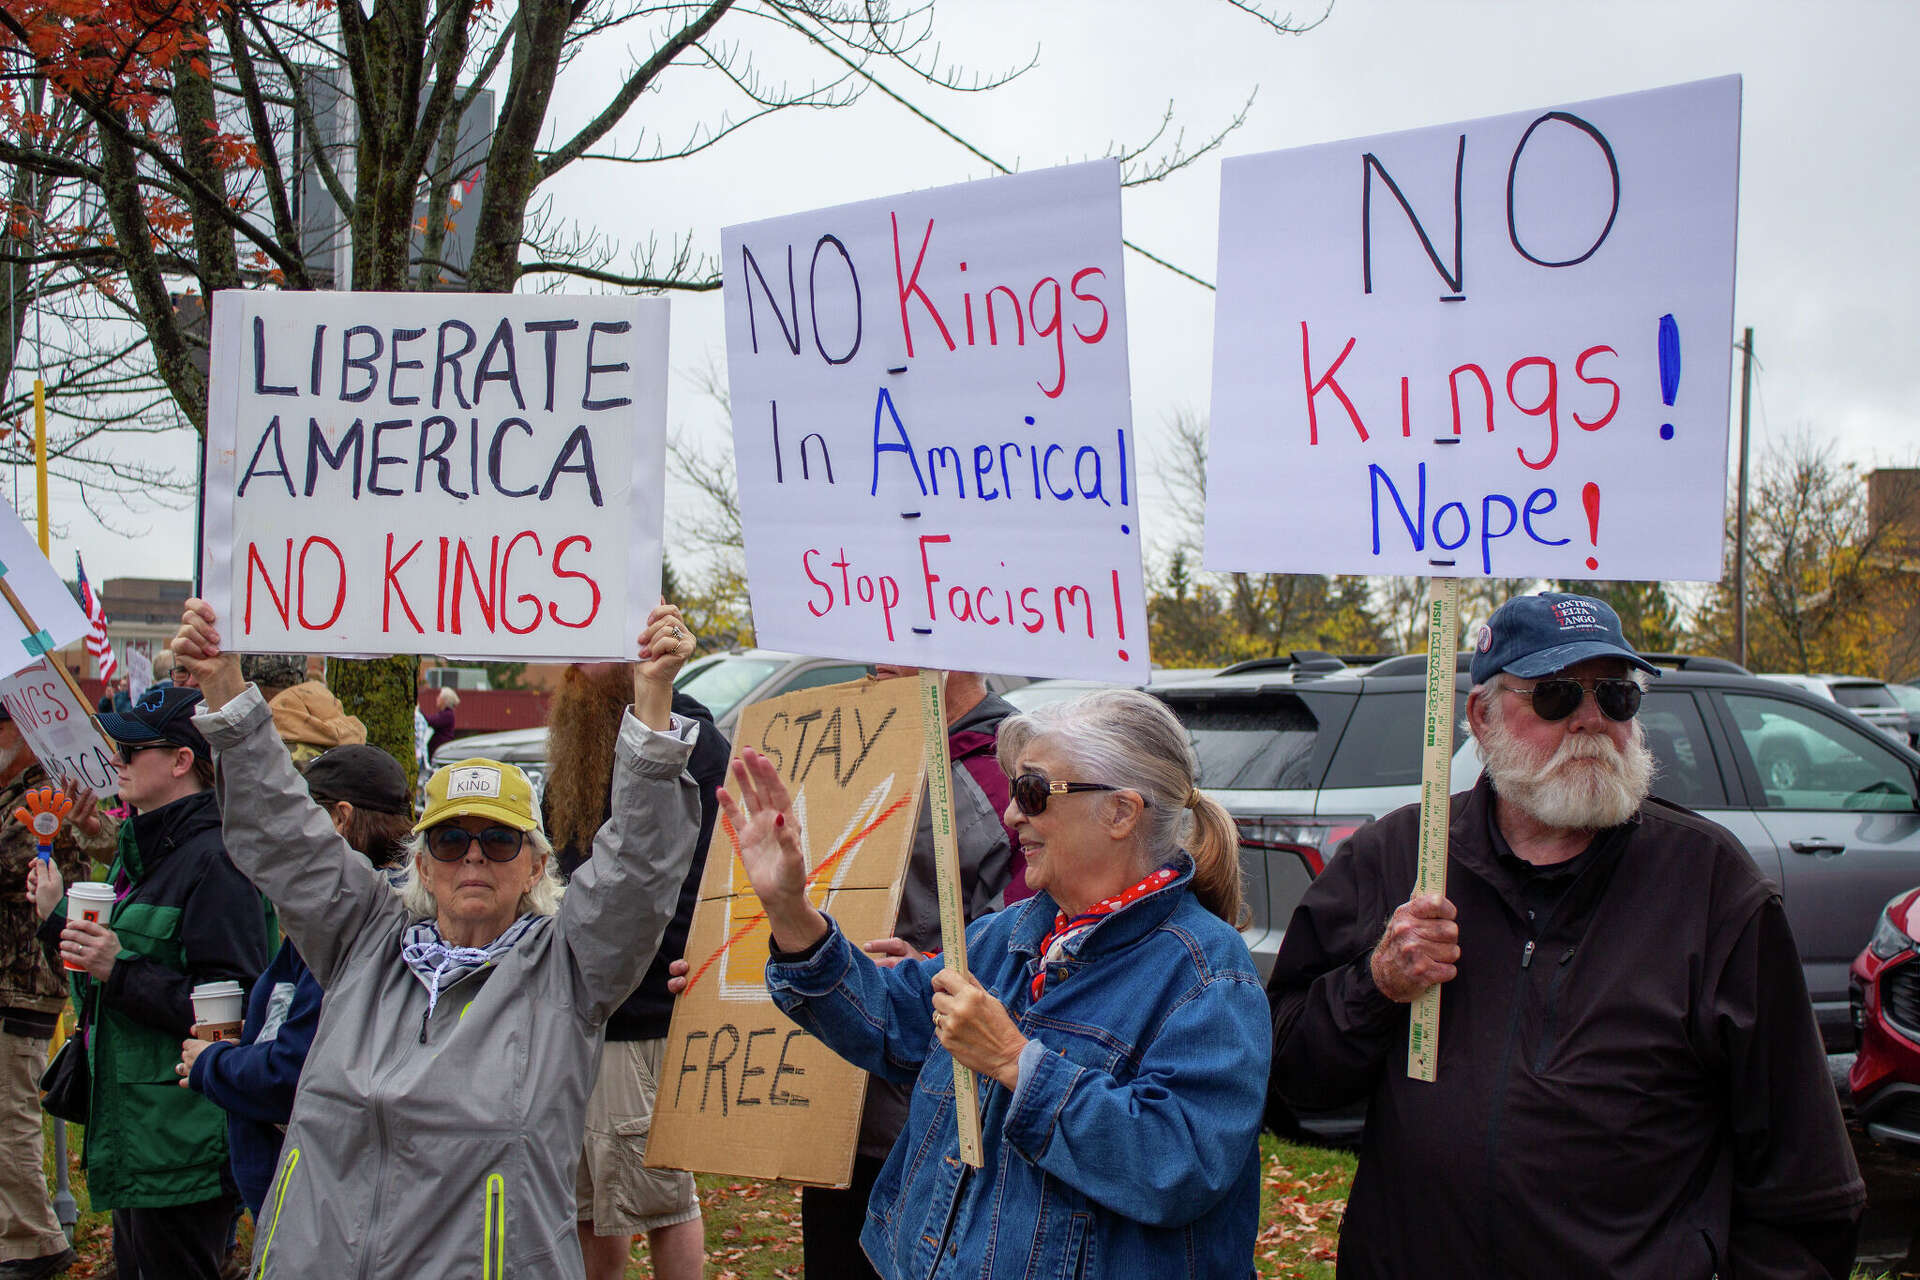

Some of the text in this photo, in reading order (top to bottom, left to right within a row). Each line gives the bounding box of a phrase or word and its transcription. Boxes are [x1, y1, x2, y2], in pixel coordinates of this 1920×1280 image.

[1362, 111, 1620, 294] NO
[743, 211, 1109, 399] NO Kings
[253, 315, 632, 411] LIBERATE
[237, 414, 604, 507] AMERICA
[770, 387, 1131, 535] In America!
[1369, 462, 1601, 575] Nope!
[245, 529, 602, 635] NO KINGS
[803, 534, 1130, 662] Stop Facism!
[1432, 599, 1442, 628] VISIT
[1554, 607, 1591, 617] DELTA
[1556, 615, 1596, 627] TANGO
[457, 780, 490, 792] KIND
[761, 706, 898, 790] STAY
[675, 1024, 812, 1117] FREE
